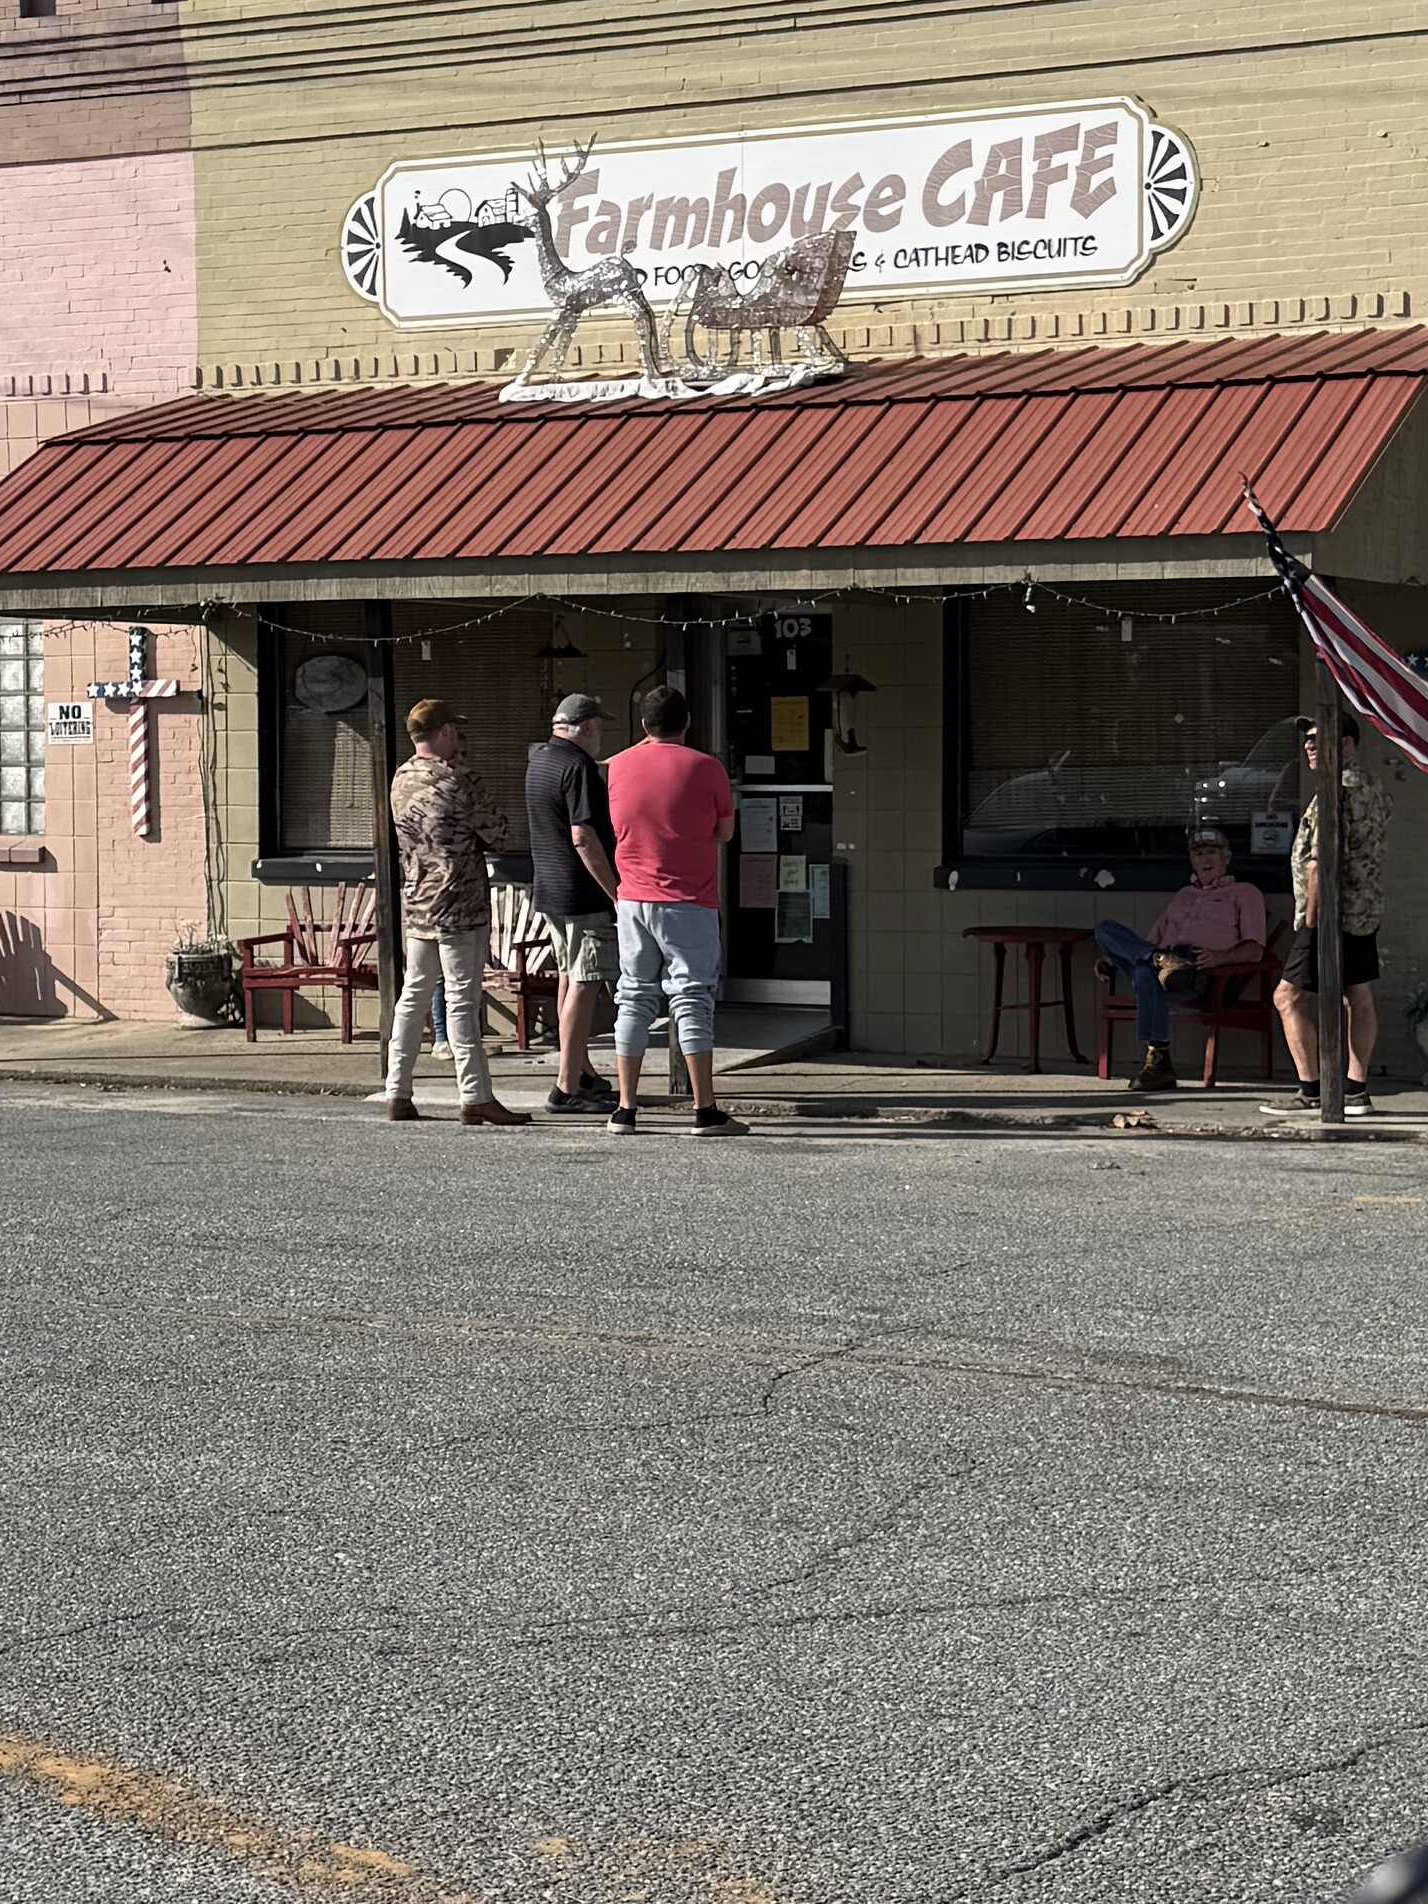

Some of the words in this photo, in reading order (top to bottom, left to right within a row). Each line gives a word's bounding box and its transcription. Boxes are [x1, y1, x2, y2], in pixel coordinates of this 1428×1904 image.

[554, 166, 907, 258] Farmhouse
[921, 121, 1120, 228] CAFE
[893, 242, 991, 269] CATHEAD
[996, 235, 1099, 263] BISCUITS
[773, 617, 813, 639] 103
[58, 704, 82, 721] NO
